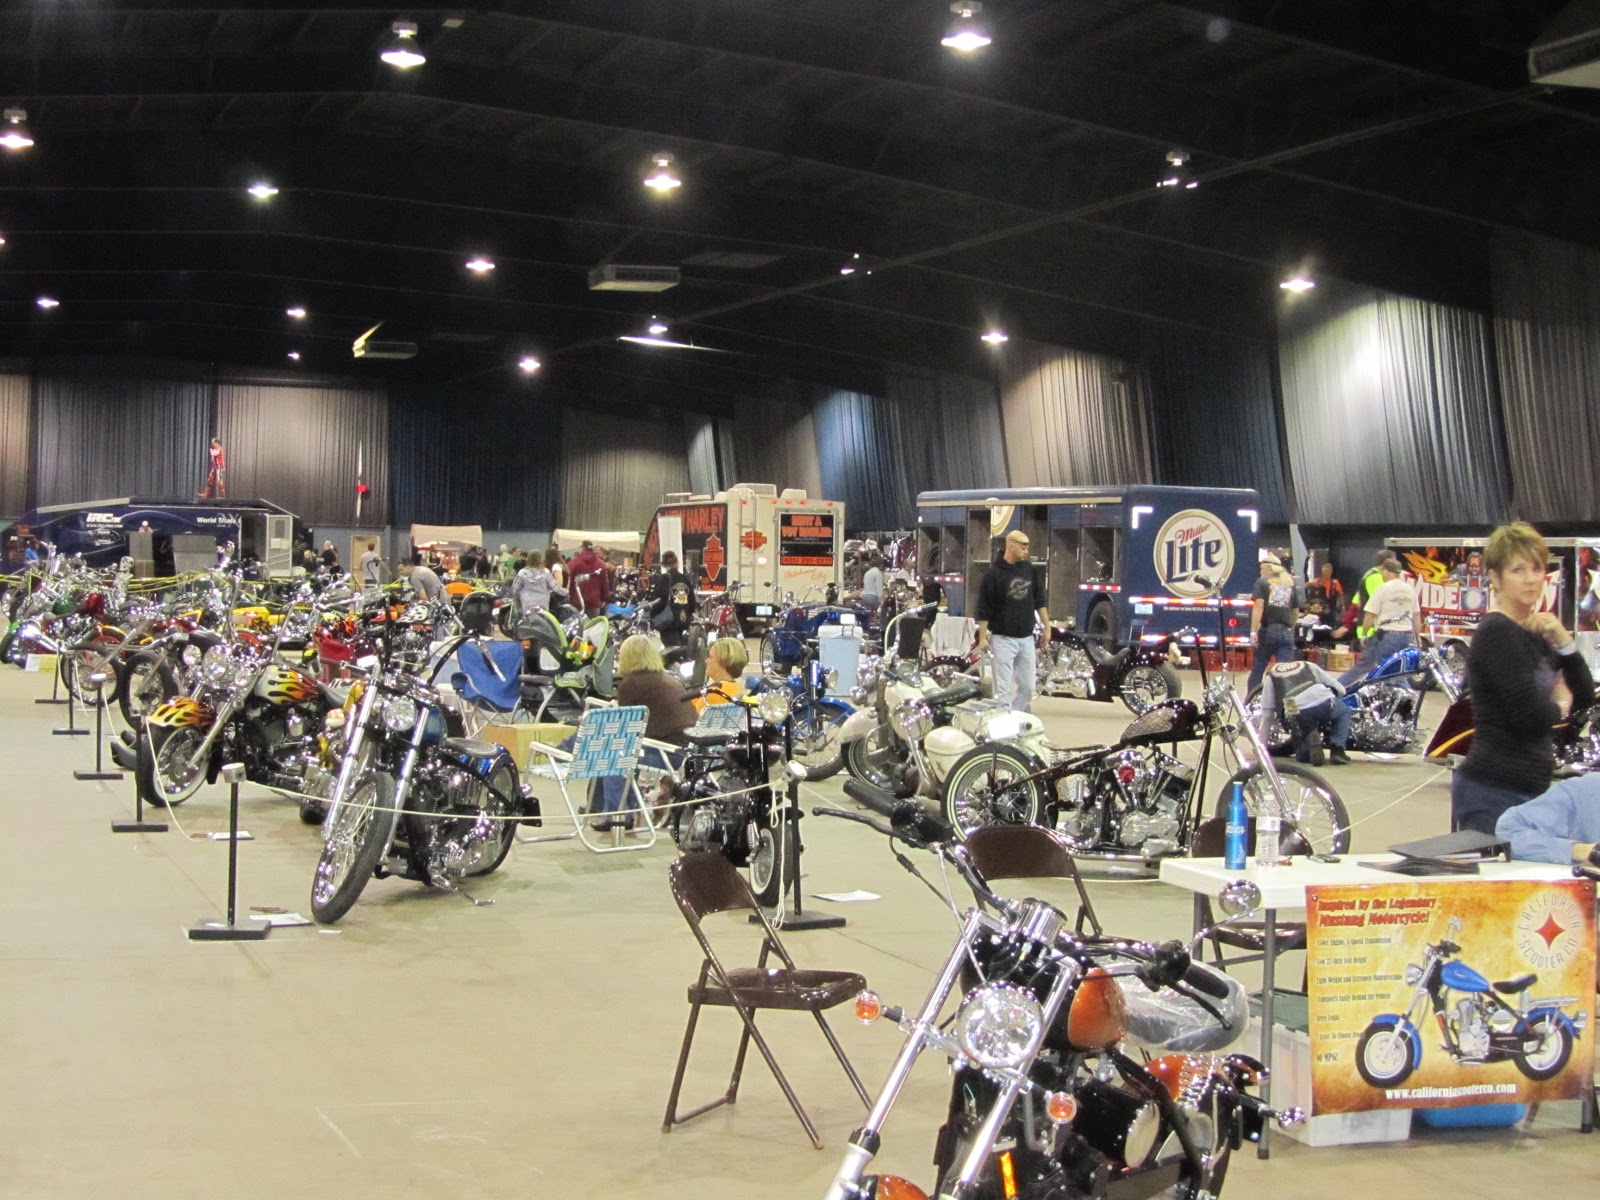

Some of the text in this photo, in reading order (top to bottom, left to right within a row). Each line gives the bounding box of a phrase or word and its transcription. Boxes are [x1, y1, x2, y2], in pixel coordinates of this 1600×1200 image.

[197, 516, 236, 524] World Trials
[1175, 523, 1211, 544] Miller
[1164, 537, 1224, 584] Lite
[1434, 613, 1477, 621] MOTORCYCLE
[1358, 899, 1370, 911] by
[1372, 898, 1387, 910] the
[1388, 898, 1437, 910] Legendary
[1517, 892, 1581, 930] CALIFORNIA
[1319, 911, 1430, 928] Mustang Motorcycle!
[1518, 939, 1565, 969] SCOOTER
[1385, 1083, 1517, 1100] www.californiascooterco.com
